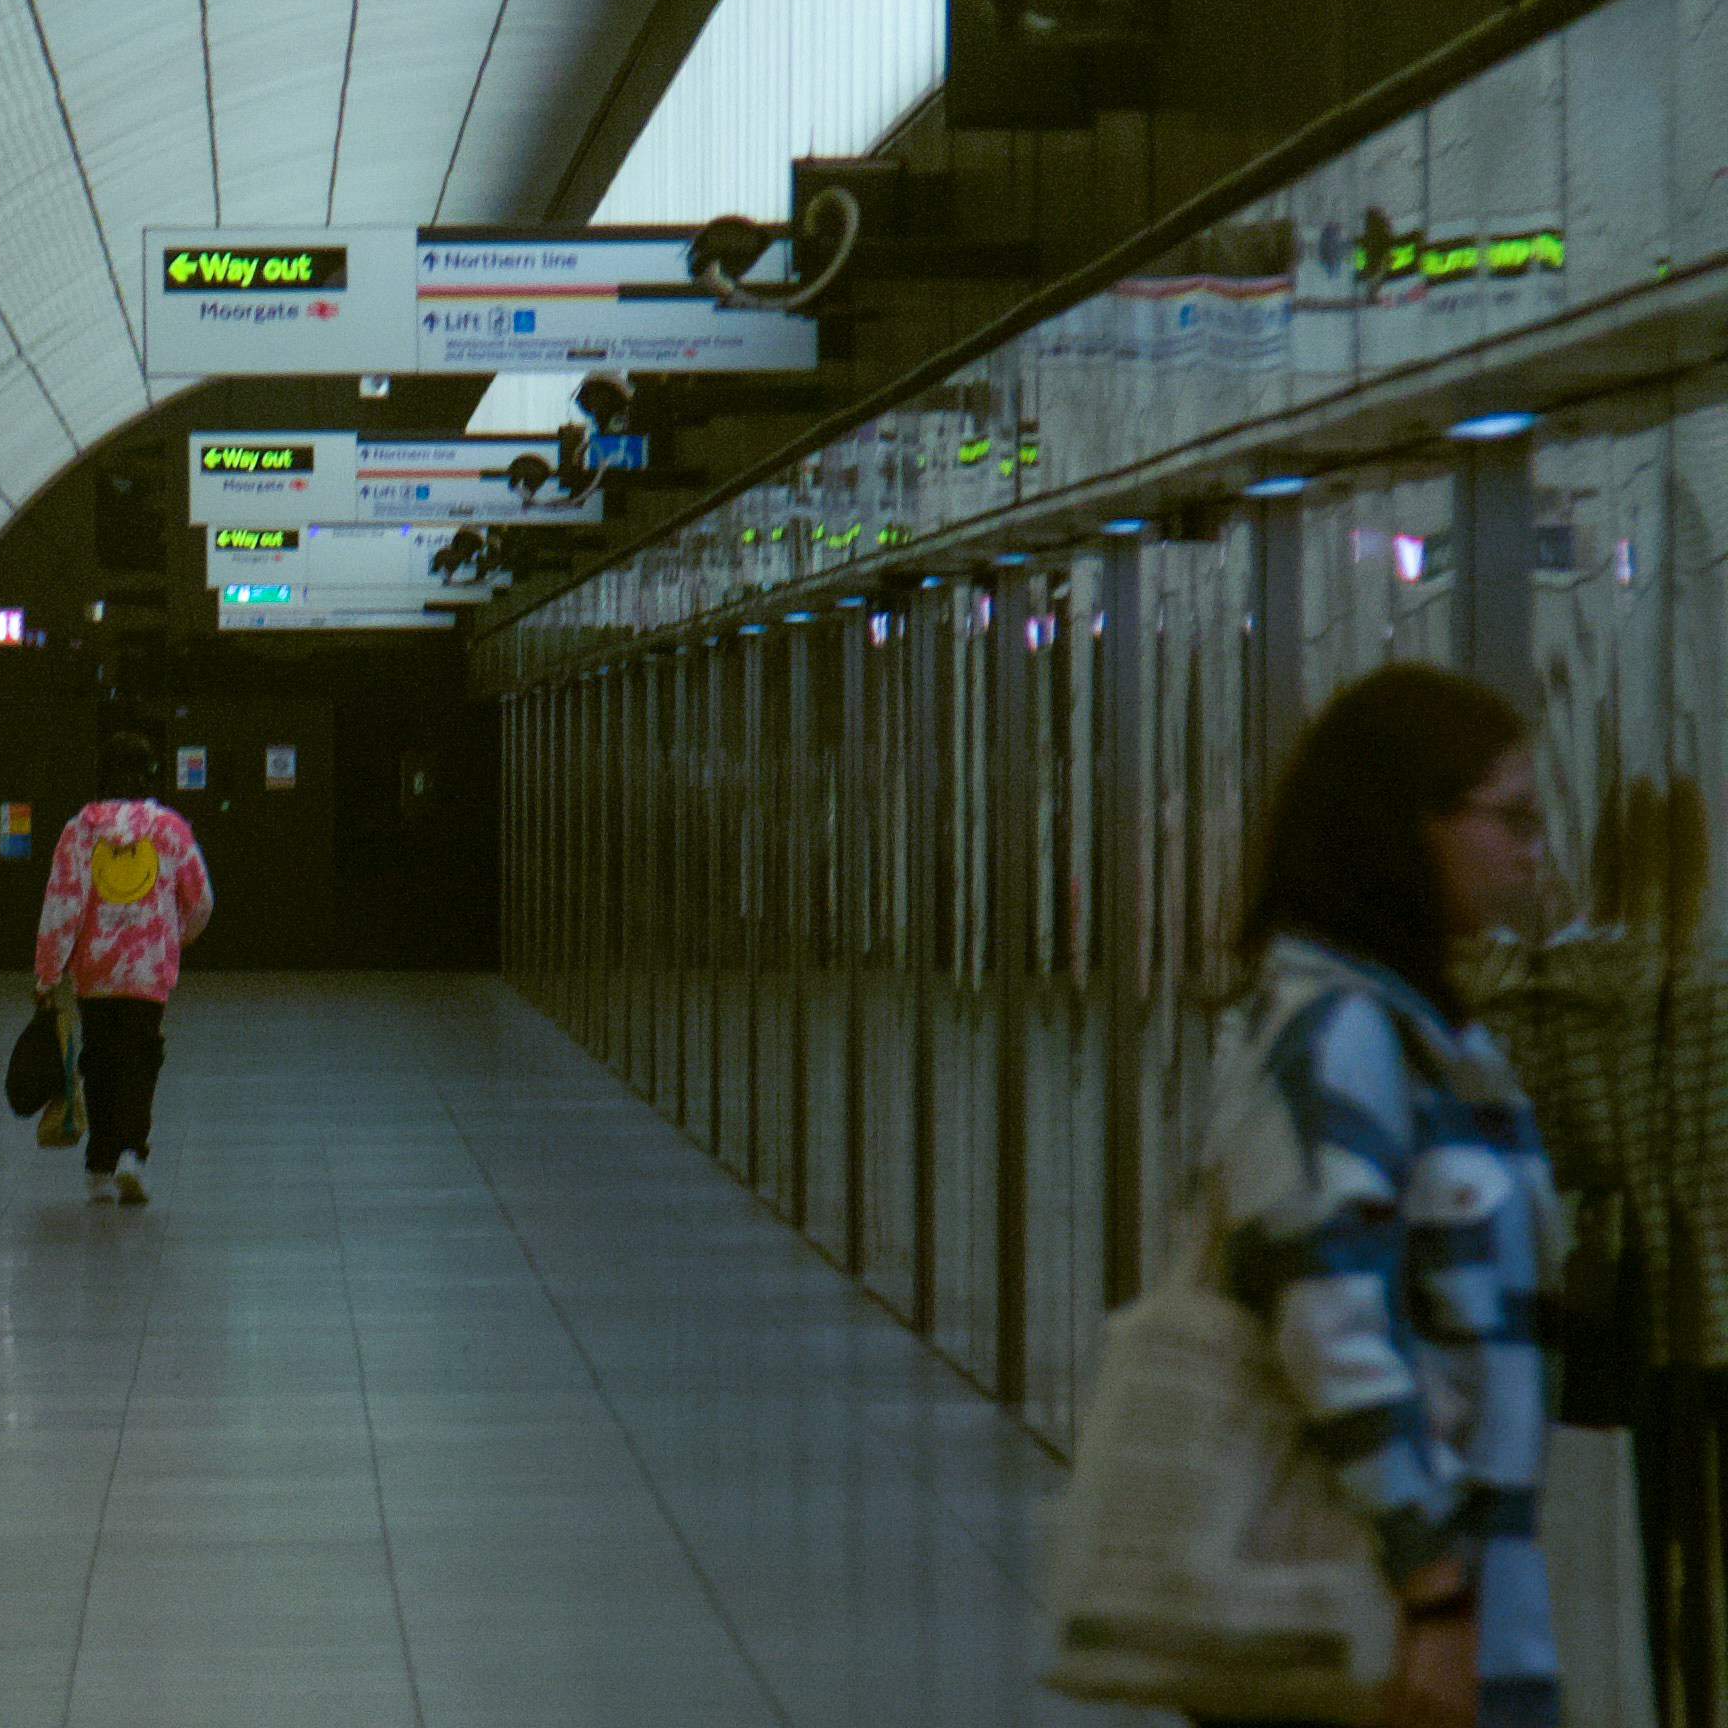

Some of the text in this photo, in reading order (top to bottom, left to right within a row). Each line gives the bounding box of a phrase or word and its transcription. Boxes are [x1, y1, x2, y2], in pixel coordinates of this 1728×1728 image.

[198, 251, 313, 289] Way out
[443, 251, 578, 269] Northern line
[199, 301, 299, 323] Moorgate
[444, 310, 481, 333] Lift
[222, 447, 293, 472] Way out
[232, 529, 284, 550] Way out
